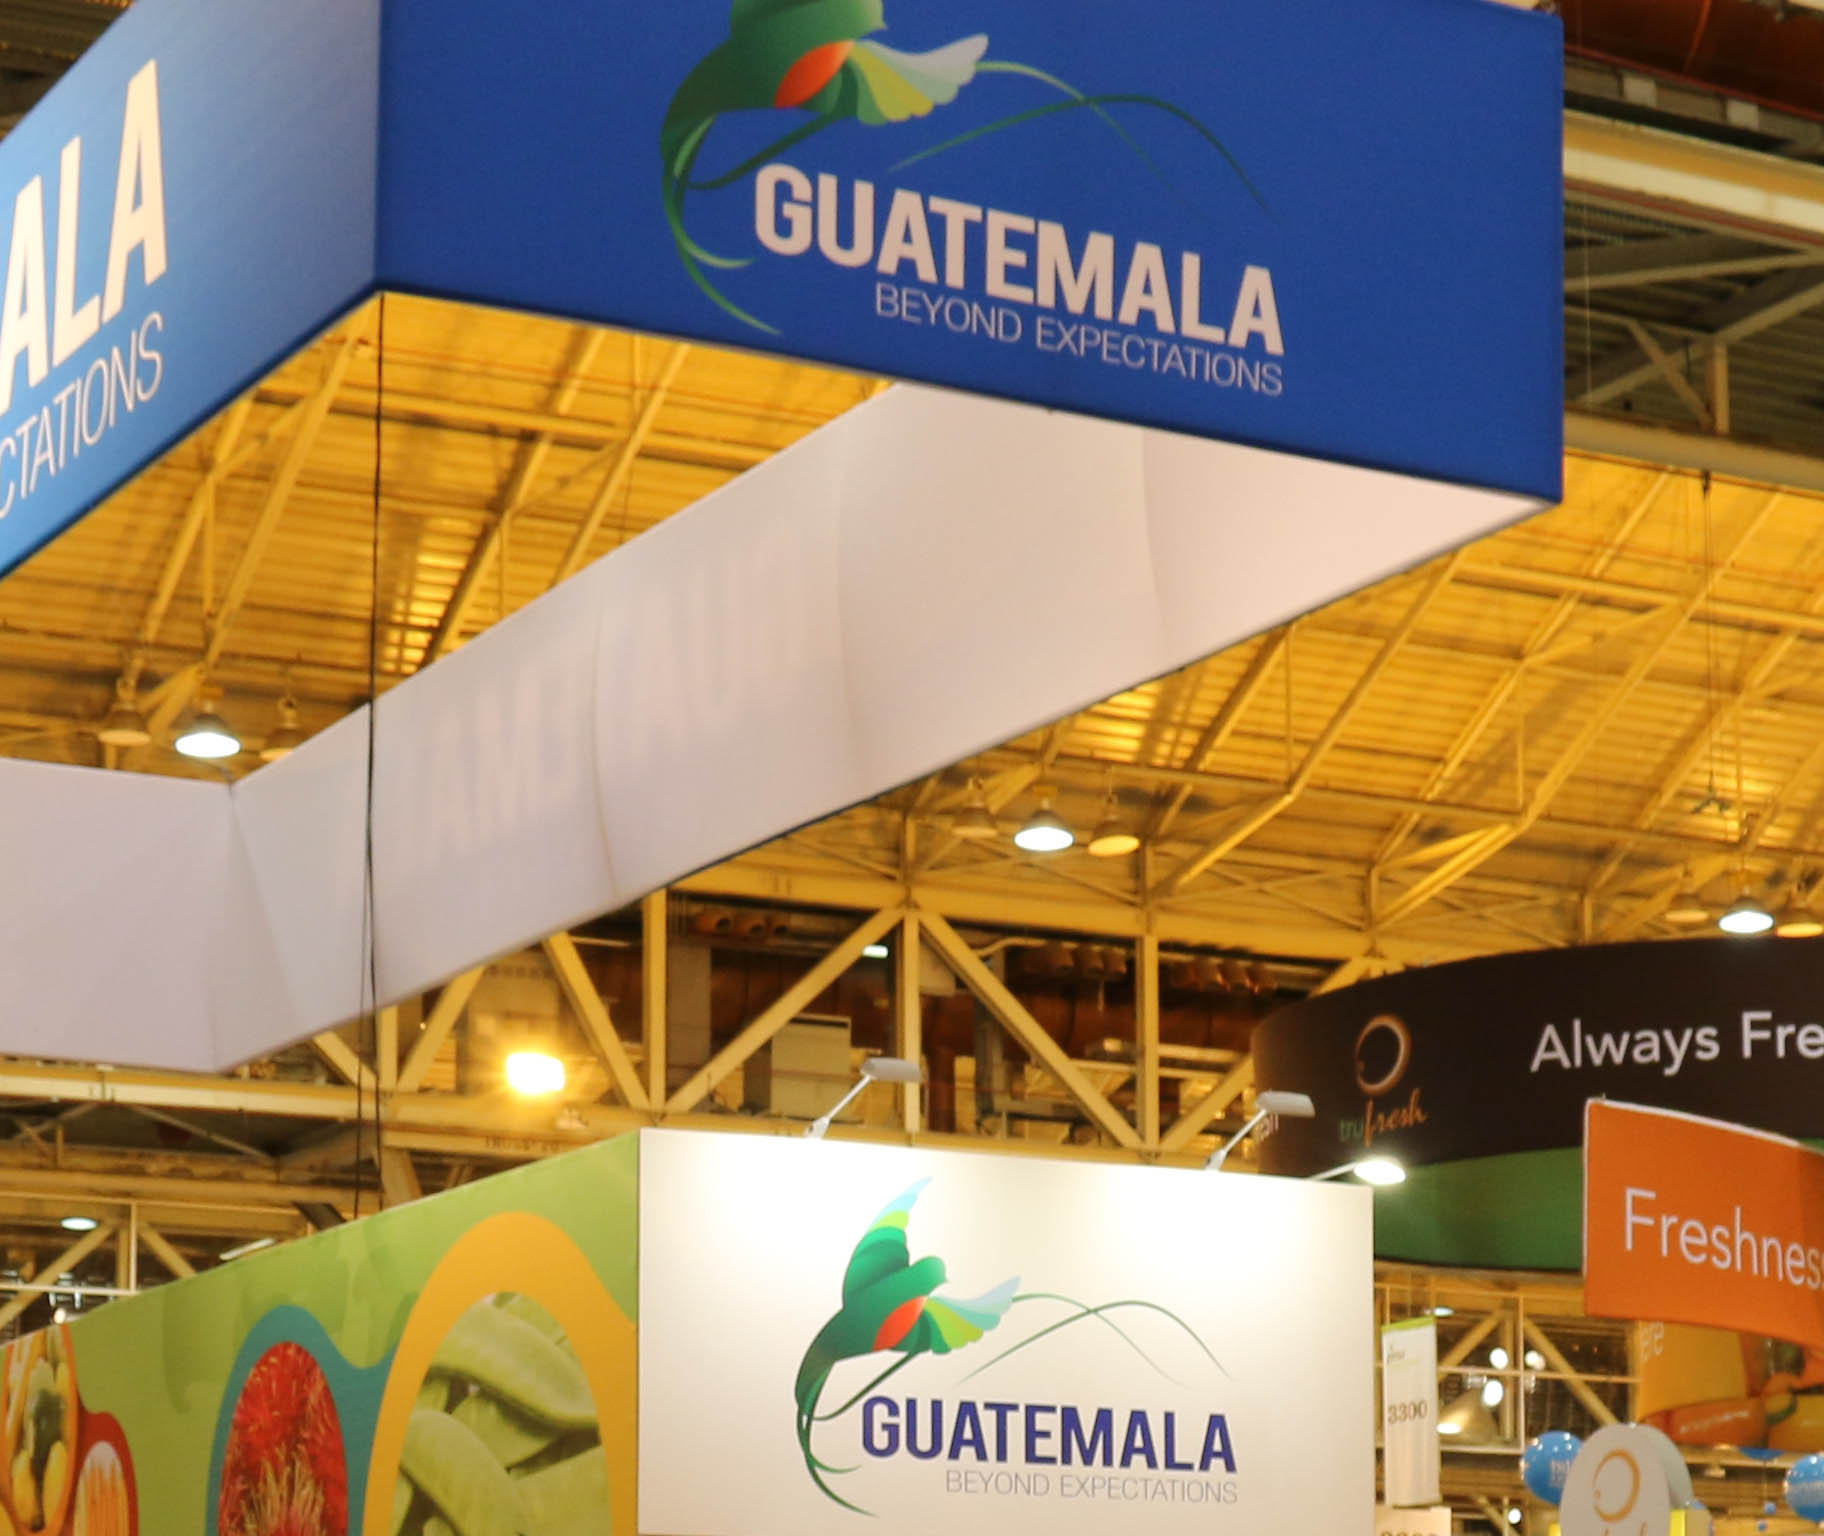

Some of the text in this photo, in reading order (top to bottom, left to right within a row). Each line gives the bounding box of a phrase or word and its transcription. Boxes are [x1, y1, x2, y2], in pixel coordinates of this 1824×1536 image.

[755, 163, 1284, 356] GUATEMALA
[875, 282, 1283, 396] BEYOND EXPECTATIONS
[1530, 1018, 1720, 1075] Always
[863, 1395, 1237, 1473] GUATEMALA
[1388, 1401, 1427, 1424] 3300
[945, 1469, 1238, 1505] BEYOND EXPECTATIONS
